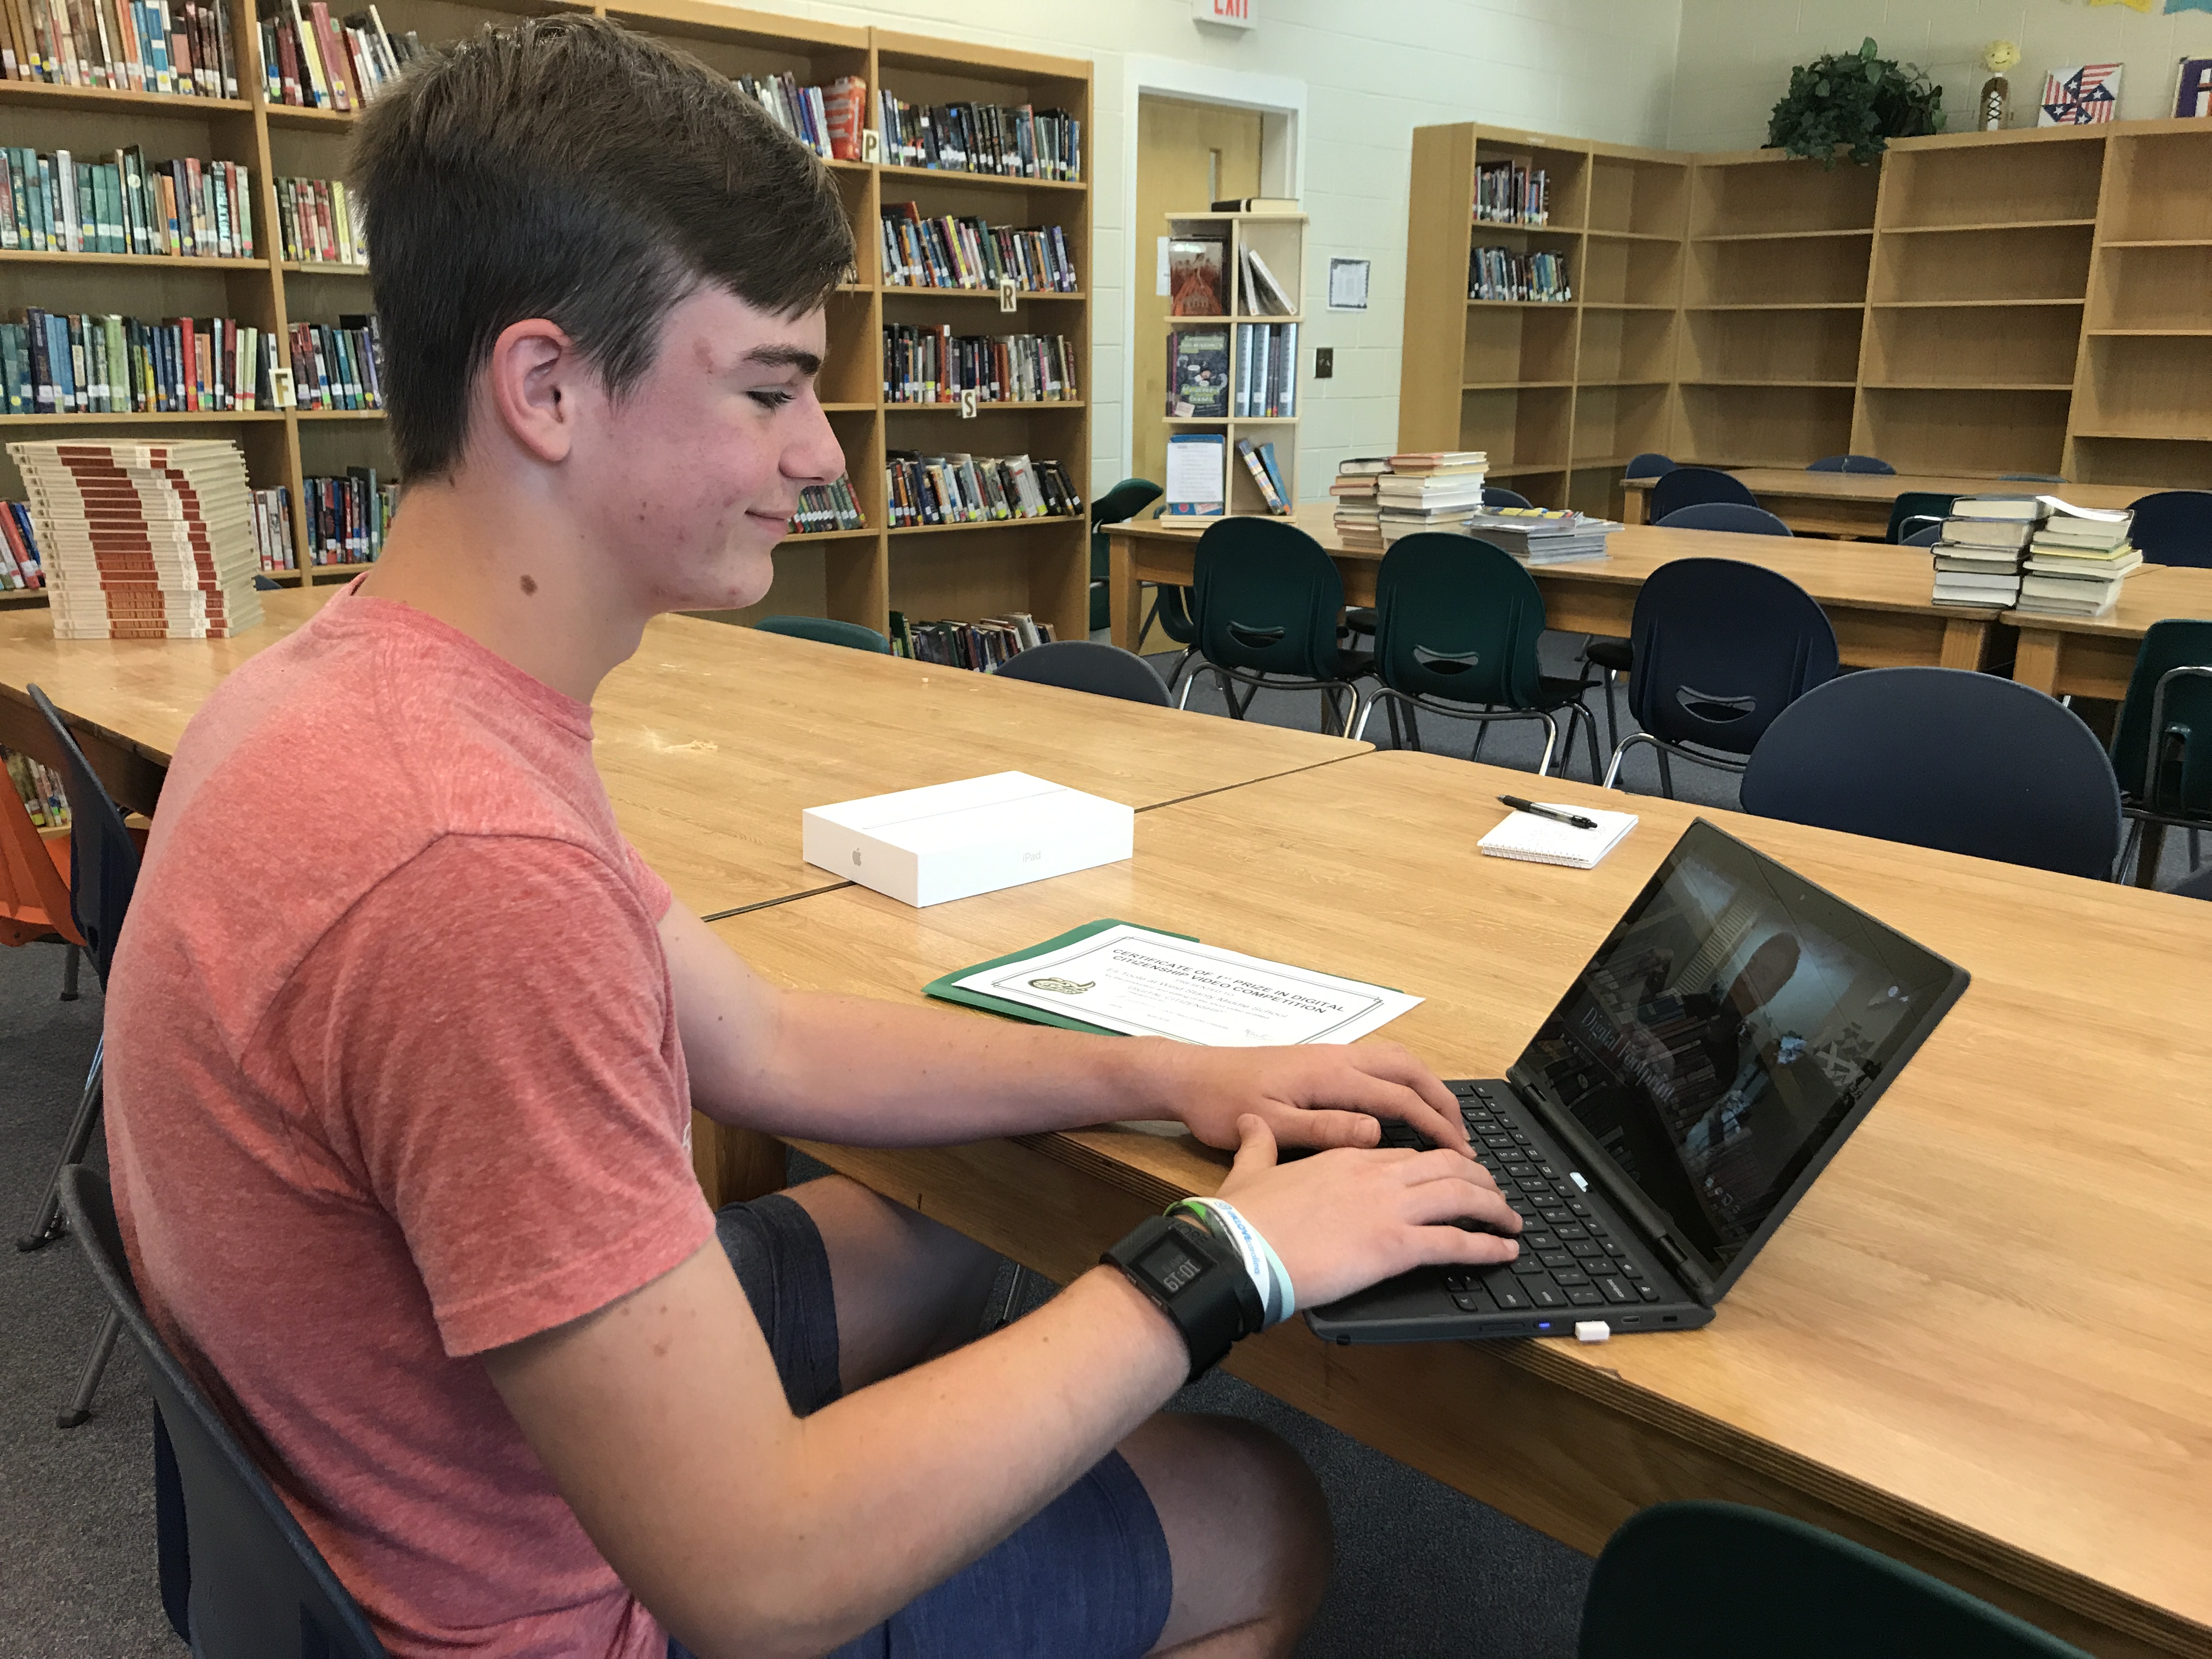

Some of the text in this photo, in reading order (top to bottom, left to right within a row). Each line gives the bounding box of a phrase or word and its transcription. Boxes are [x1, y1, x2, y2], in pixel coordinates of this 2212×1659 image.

[866, 134, 877, 160] P
[1003, 285, 1013, 309] R
[275, 373, 289, 405] F
[964, 392, 974, 416] S
[1023, 850, 1041, 863] iPad
[1113, 949, 1193, 972] CERTIFICATE
[1233, 979, 1273, 992] PRIZE
[1291, 995, 1344, 1012] DIGITAL
[1113, 956, 1327, 1013] CITIZENSHIP VIDEO COMPETITION
[1175, 979, 1222, 993] PRESENTED
[1159, 982, 1184, 991] West
[1217, 997, 1250, 1008] Middle
[1251, 1006, 1288, 1018] School
[1581, 1007, 1623, 1052] Digital
[1617, 1040, 1675, 1103] Footprint
